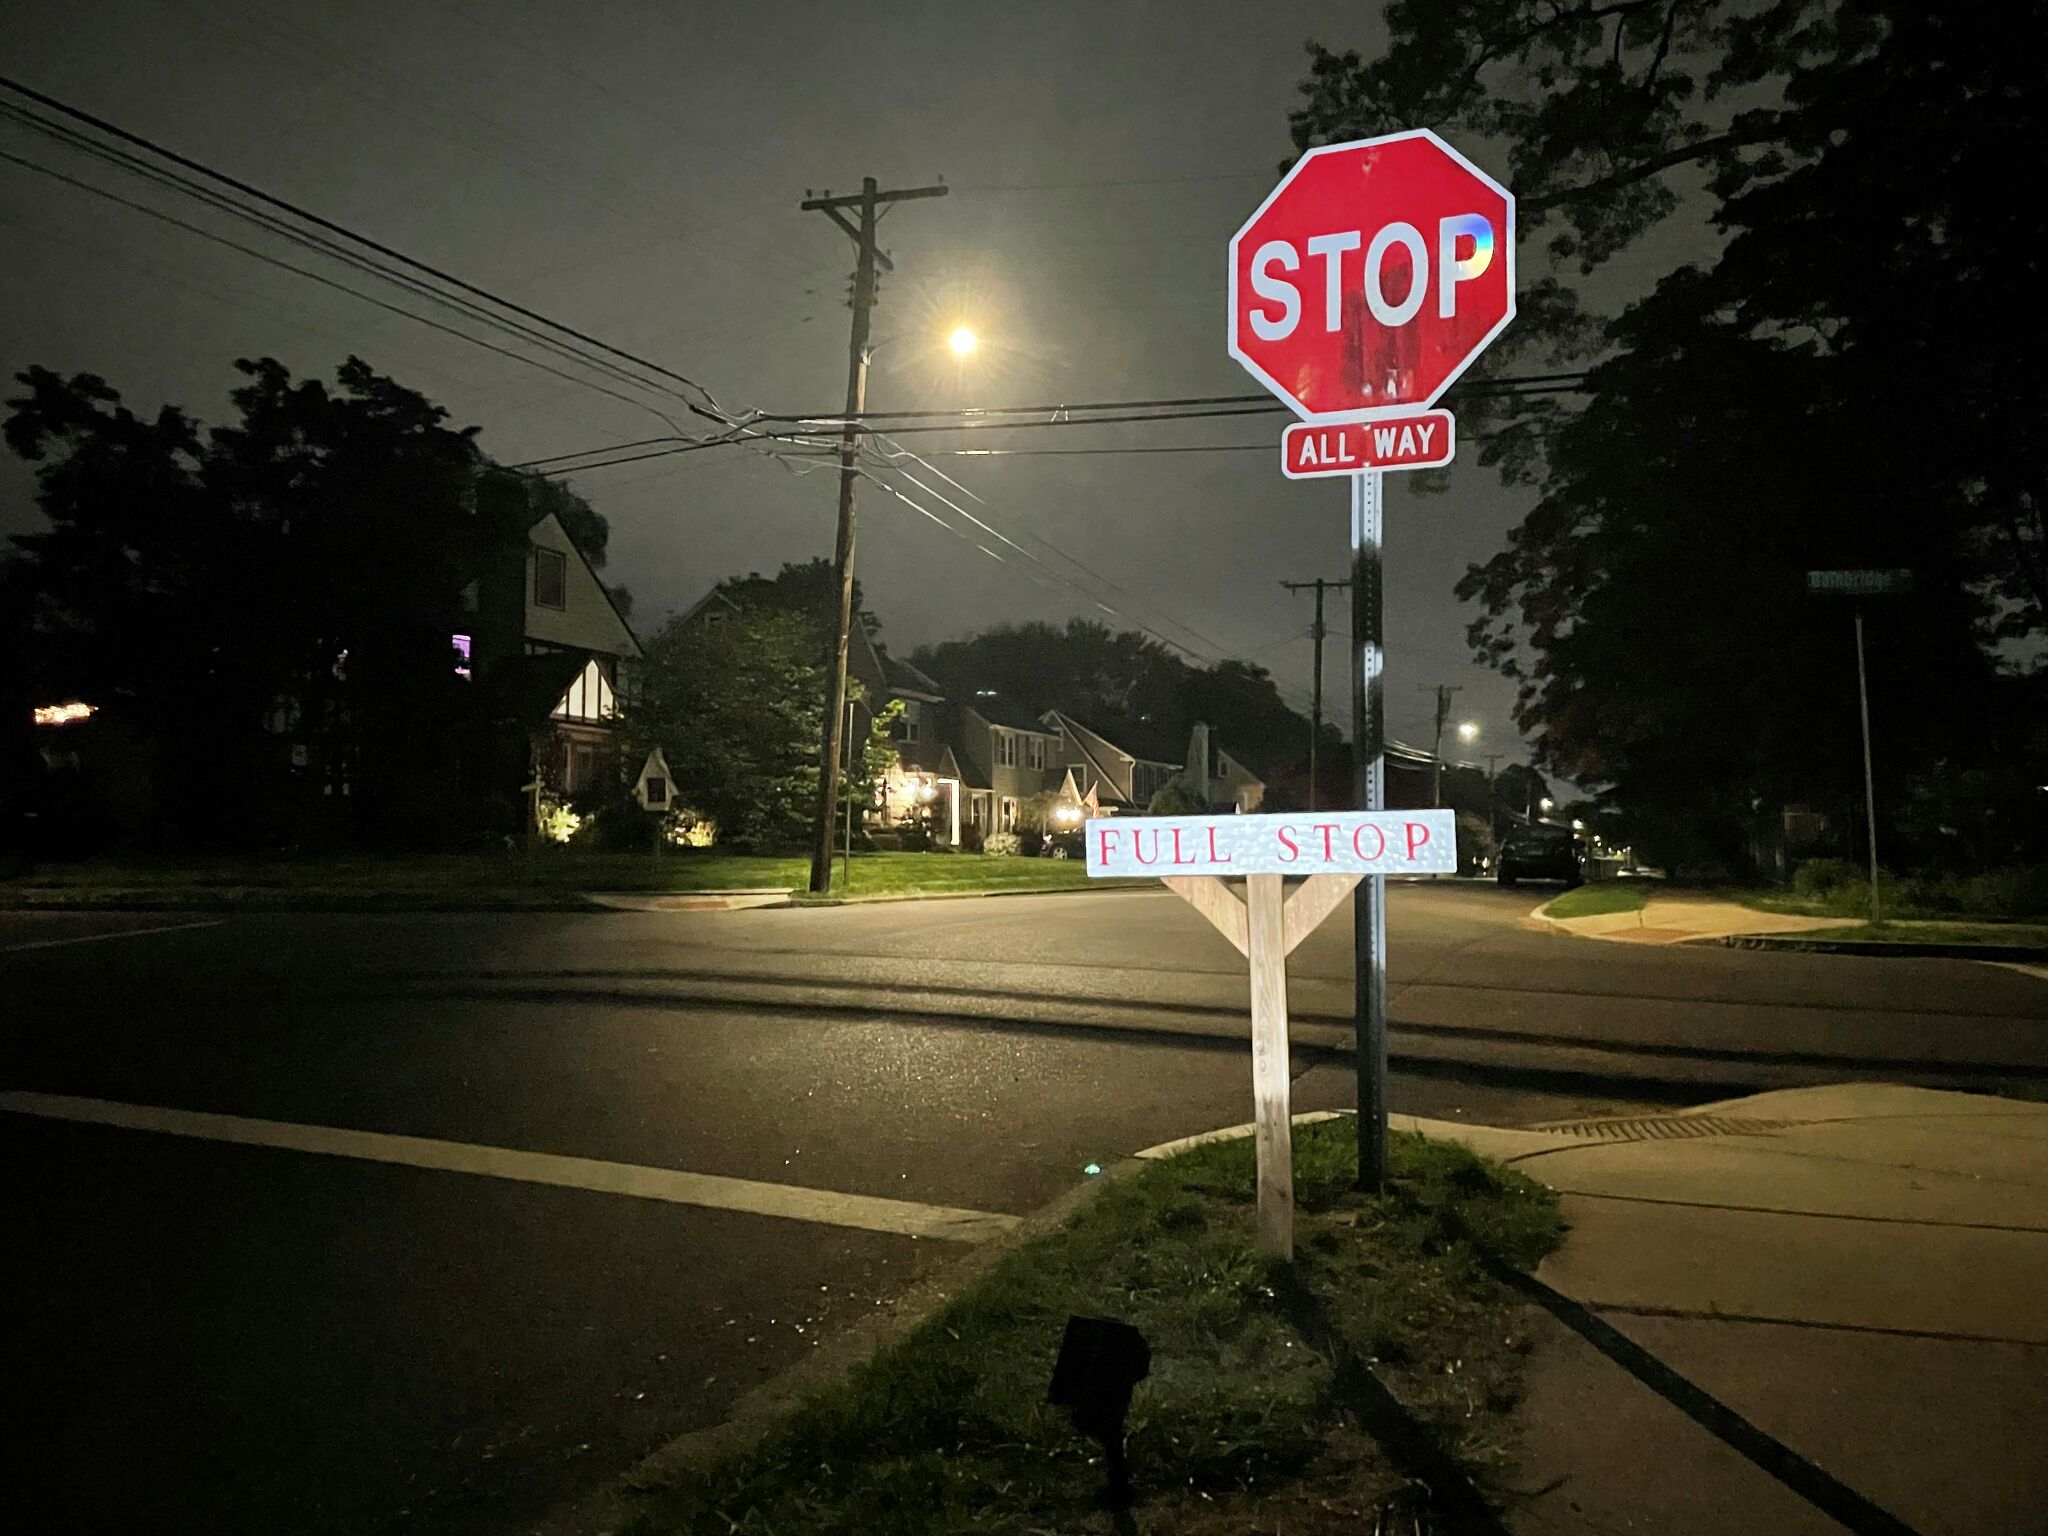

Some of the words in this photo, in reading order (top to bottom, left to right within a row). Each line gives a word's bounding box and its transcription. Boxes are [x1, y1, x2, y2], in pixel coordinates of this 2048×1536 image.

[1249, 212, 1495, 341] STOP
[1299, 433, 1356, 466] ALL
[1373, 423, 1436, 459] WAY
[1098, 826, 1233, 866] FULL
[1277, 822, 1432, 863] STOP
